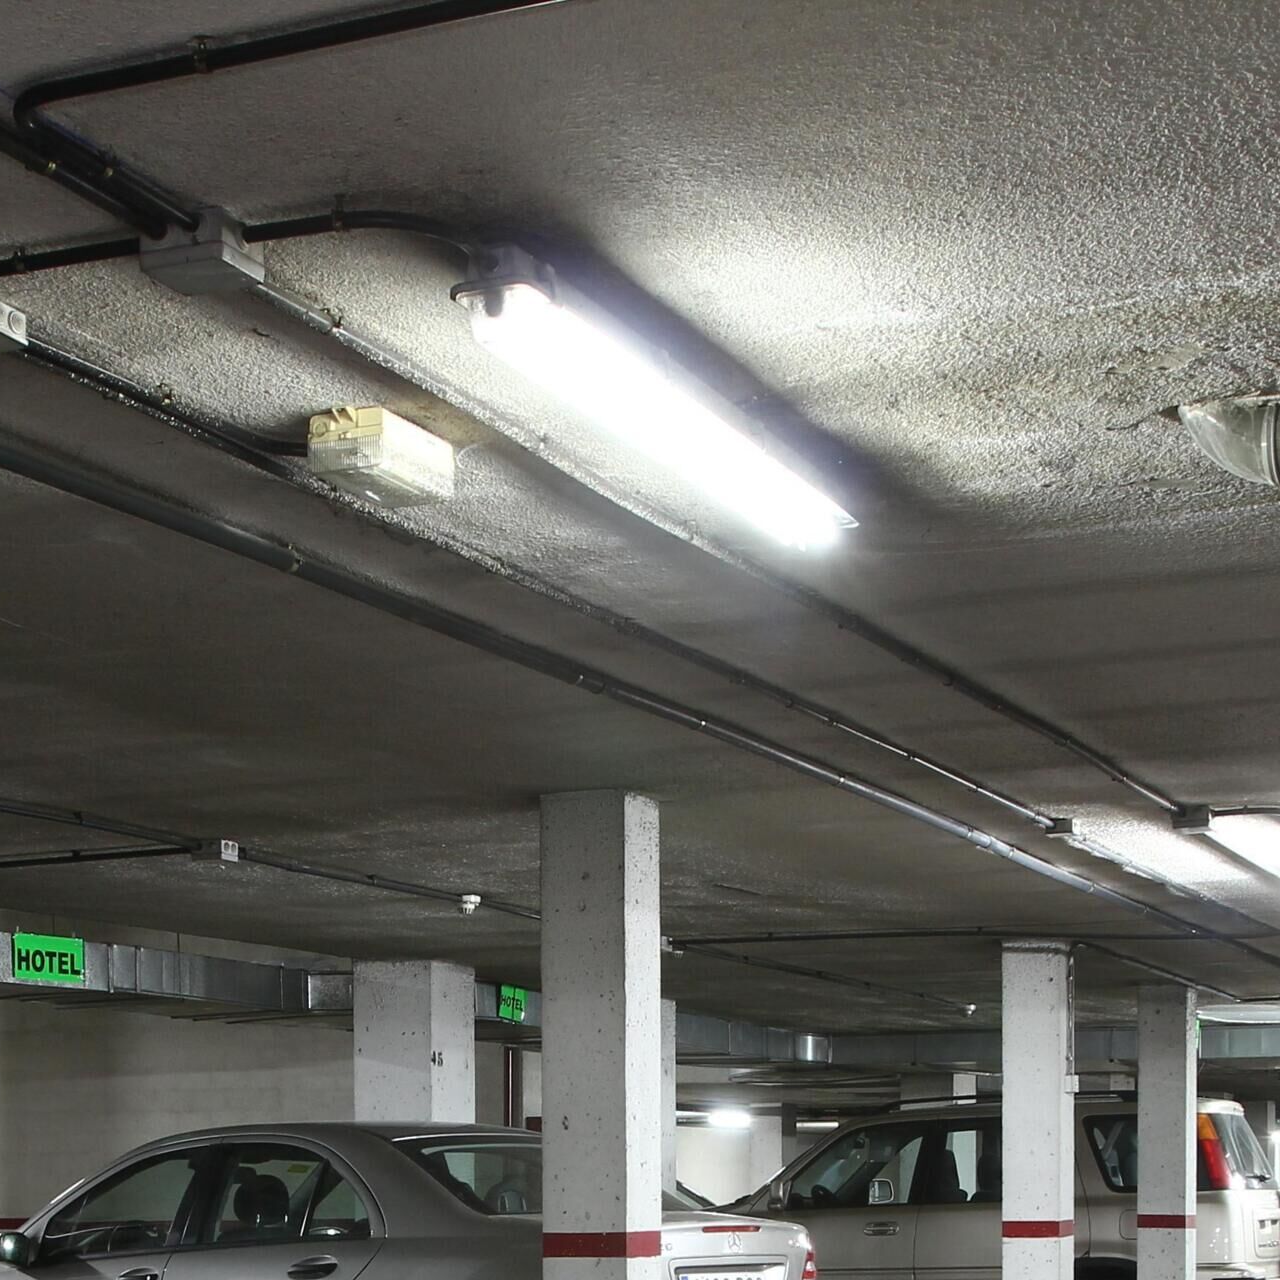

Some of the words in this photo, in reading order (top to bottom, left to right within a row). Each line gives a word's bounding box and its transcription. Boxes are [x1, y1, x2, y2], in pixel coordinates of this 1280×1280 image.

[17, 947, 81, 976] HOTEL
[500, 994, 524, 1012] HOTEL
[431, 1050, 444, 1067] 45
